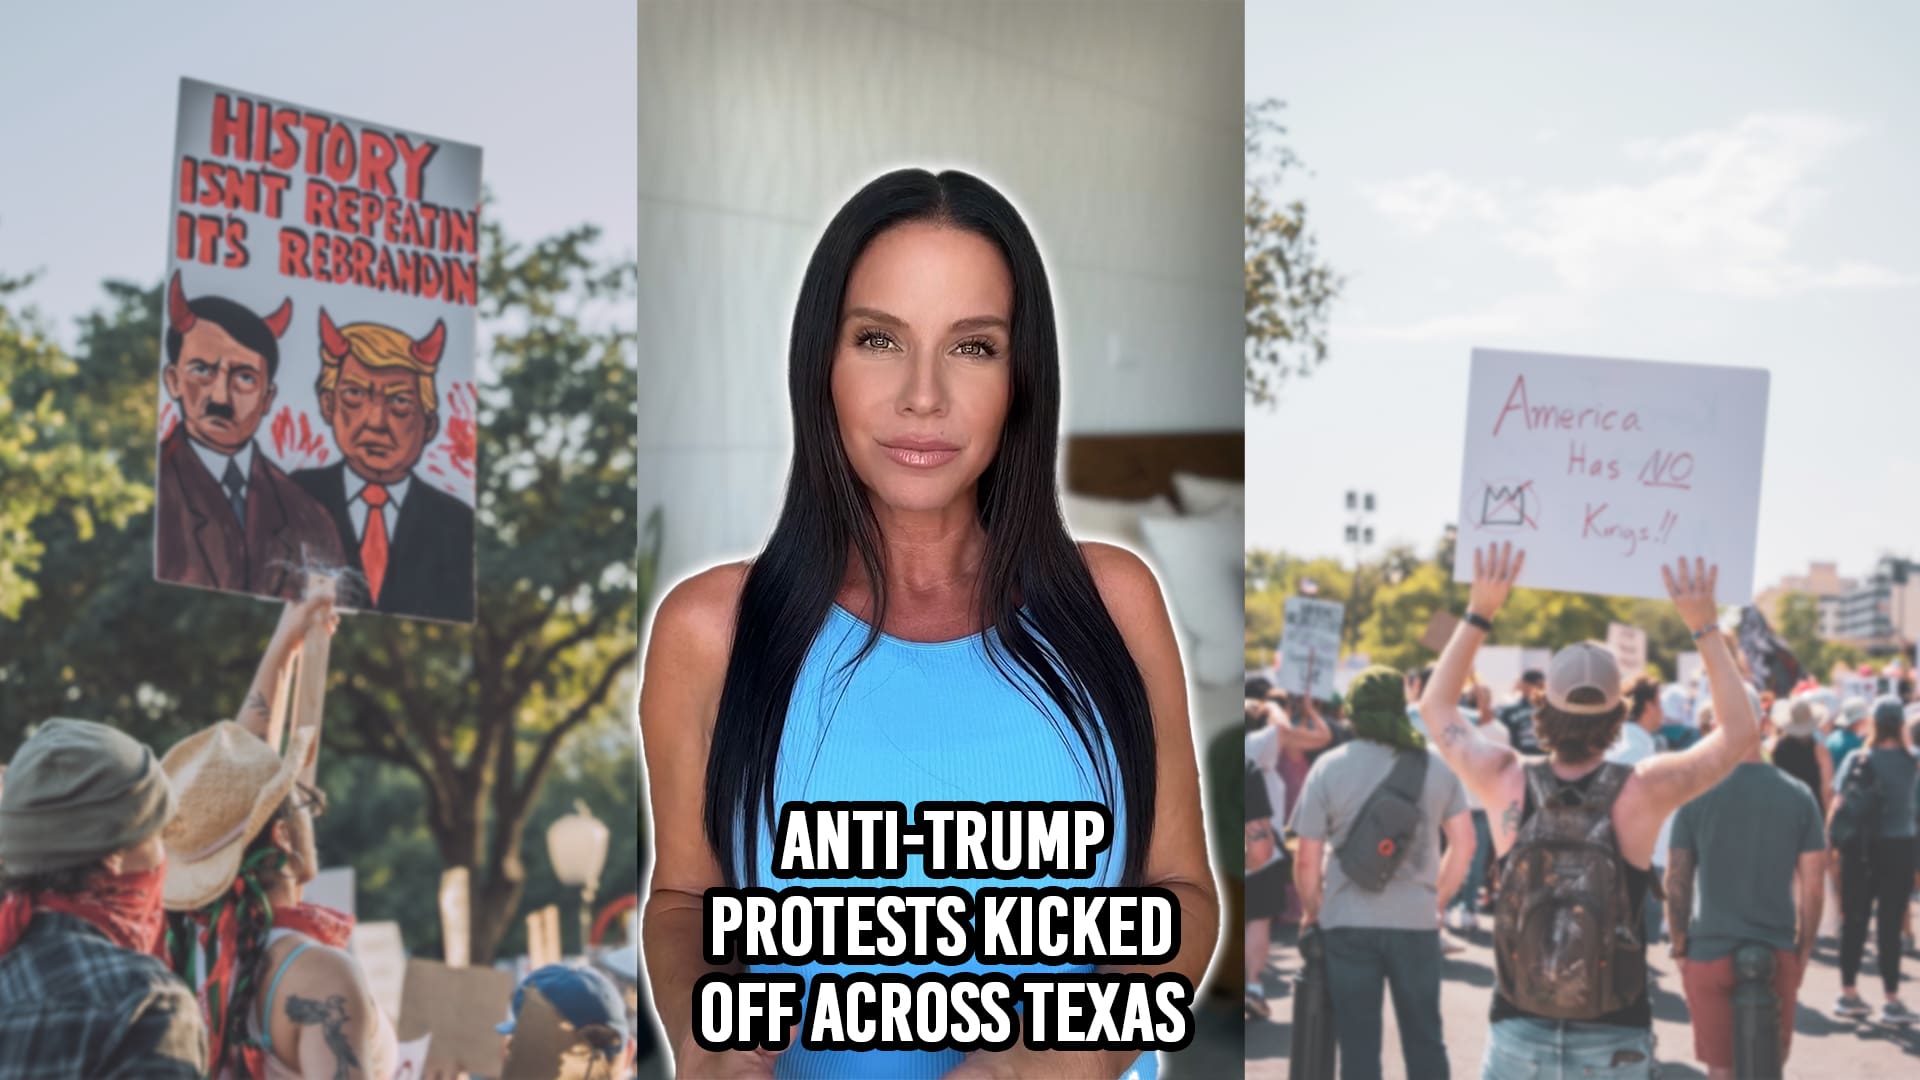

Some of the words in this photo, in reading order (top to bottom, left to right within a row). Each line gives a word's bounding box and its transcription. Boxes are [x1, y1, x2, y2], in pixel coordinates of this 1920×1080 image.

[210, 92, 439, 202] HISTORY
[175, 210, 249, 270] IT'S
[1492, 373, 1643, 437] America
[1567, 440, 1621, 481] Has
[1637, 448, 1695, 491] NO
